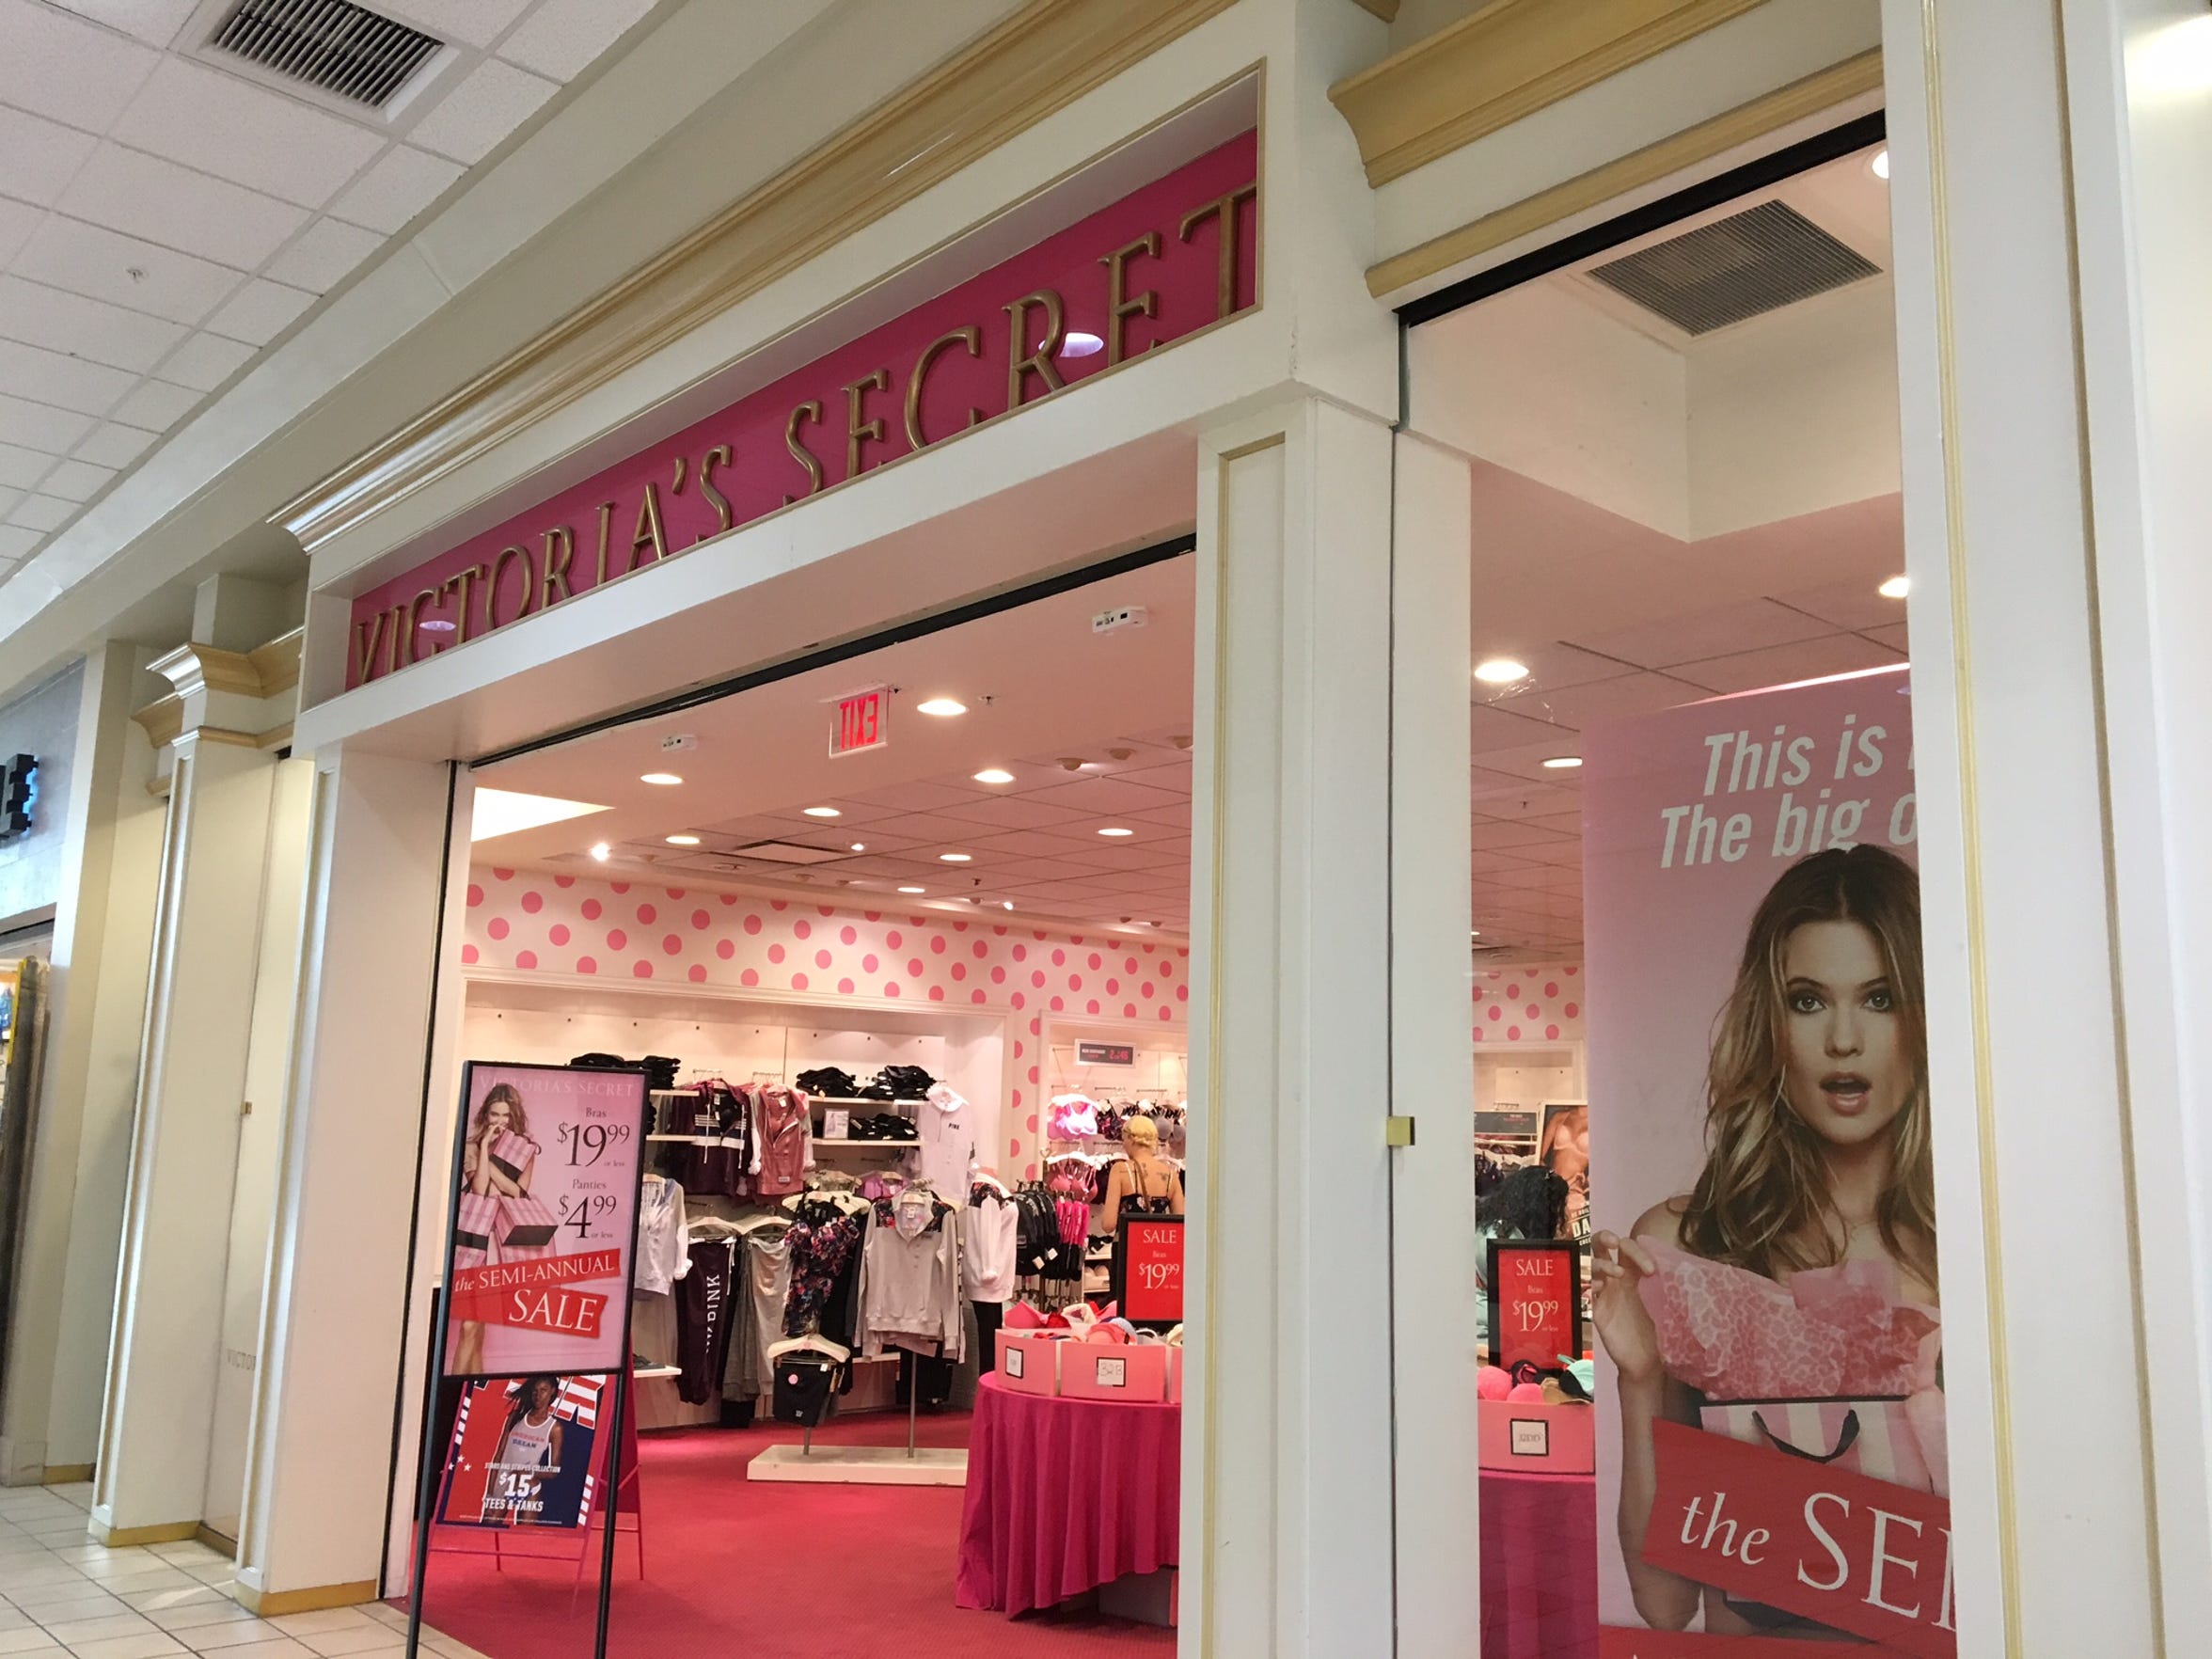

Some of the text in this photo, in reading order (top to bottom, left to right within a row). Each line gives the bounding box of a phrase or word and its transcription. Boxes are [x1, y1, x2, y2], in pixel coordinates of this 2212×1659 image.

[356, 181, 1257, 686] VICTORIA'S SECRET
[1703, 724, 1815, 797] This
[1834, 714, 1888, 780] is
[1660, 788, 1919, 869] The big o
[579, 1080, 634, 1098] SECRET
[585, 1106, 608, 1119] Bras
[572, 1177, 608, 1190] Panties
[1143, 1228, 1177, 1244] SALE
[454, 1255, 615, 1292] the SEMI-ANNUAL
[1515, 1258, 1555, 1276] SALE
[508, 1288, 598, 1332] SALE
[516, 1498, 545, 1512] TANKS
[1680, 1491, 1957, 1633] the SE
